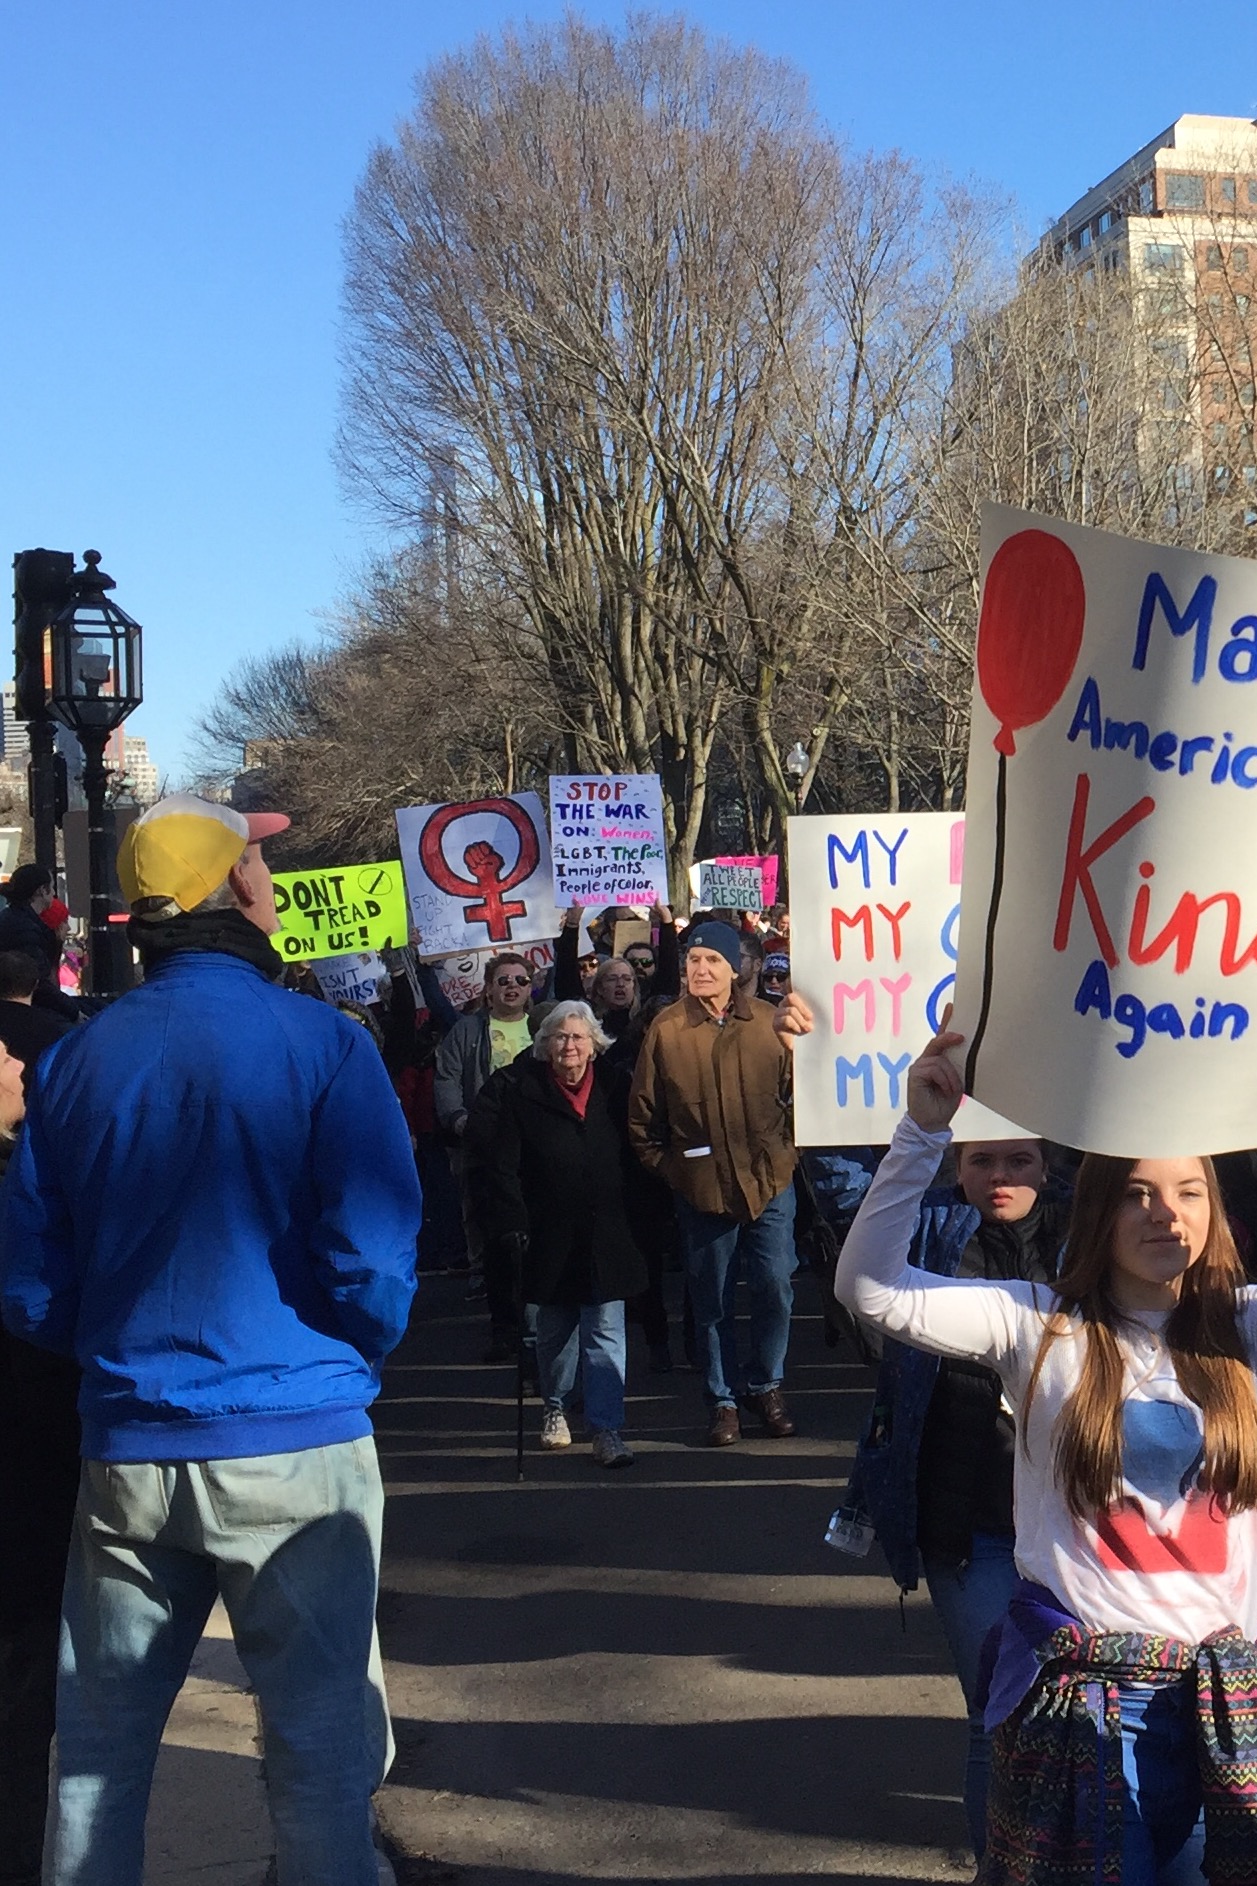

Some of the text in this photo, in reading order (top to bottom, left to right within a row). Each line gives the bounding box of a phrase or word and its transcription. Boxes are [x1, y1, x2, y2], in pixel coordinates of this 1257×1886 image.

[567, 782, 628, 800] STOP
[555, 803, 650, 820] THE WAR
[601, 826, 654, 841] Women,
[561, 846, 608, 861] LGBT,
[611, 846, 638, 860] The
[827, 827, 909, 890] MY
[556, 861, 645, 878] Immigrants,
[560, 878, 654, 894] People of Color,
[703, 873, 724, 885] ALL
[727, 875, 759, 889] PEOPLE
[413, 894, 452, 909] STAND
[711, 886, 763, 909] RESPECT
[304, 900, 382, 931] TREAD
[425, 908, 443, 921] UP
[284, 926, 370, 955] ON US!
[831, 901, 911, 962] MY
[424, 933, 470, 953] BACK!
[833, 972, 912, 1038] MY
[1073, 960, 1250, 1059] Again
[835, 1051, 912, 1109] MY
